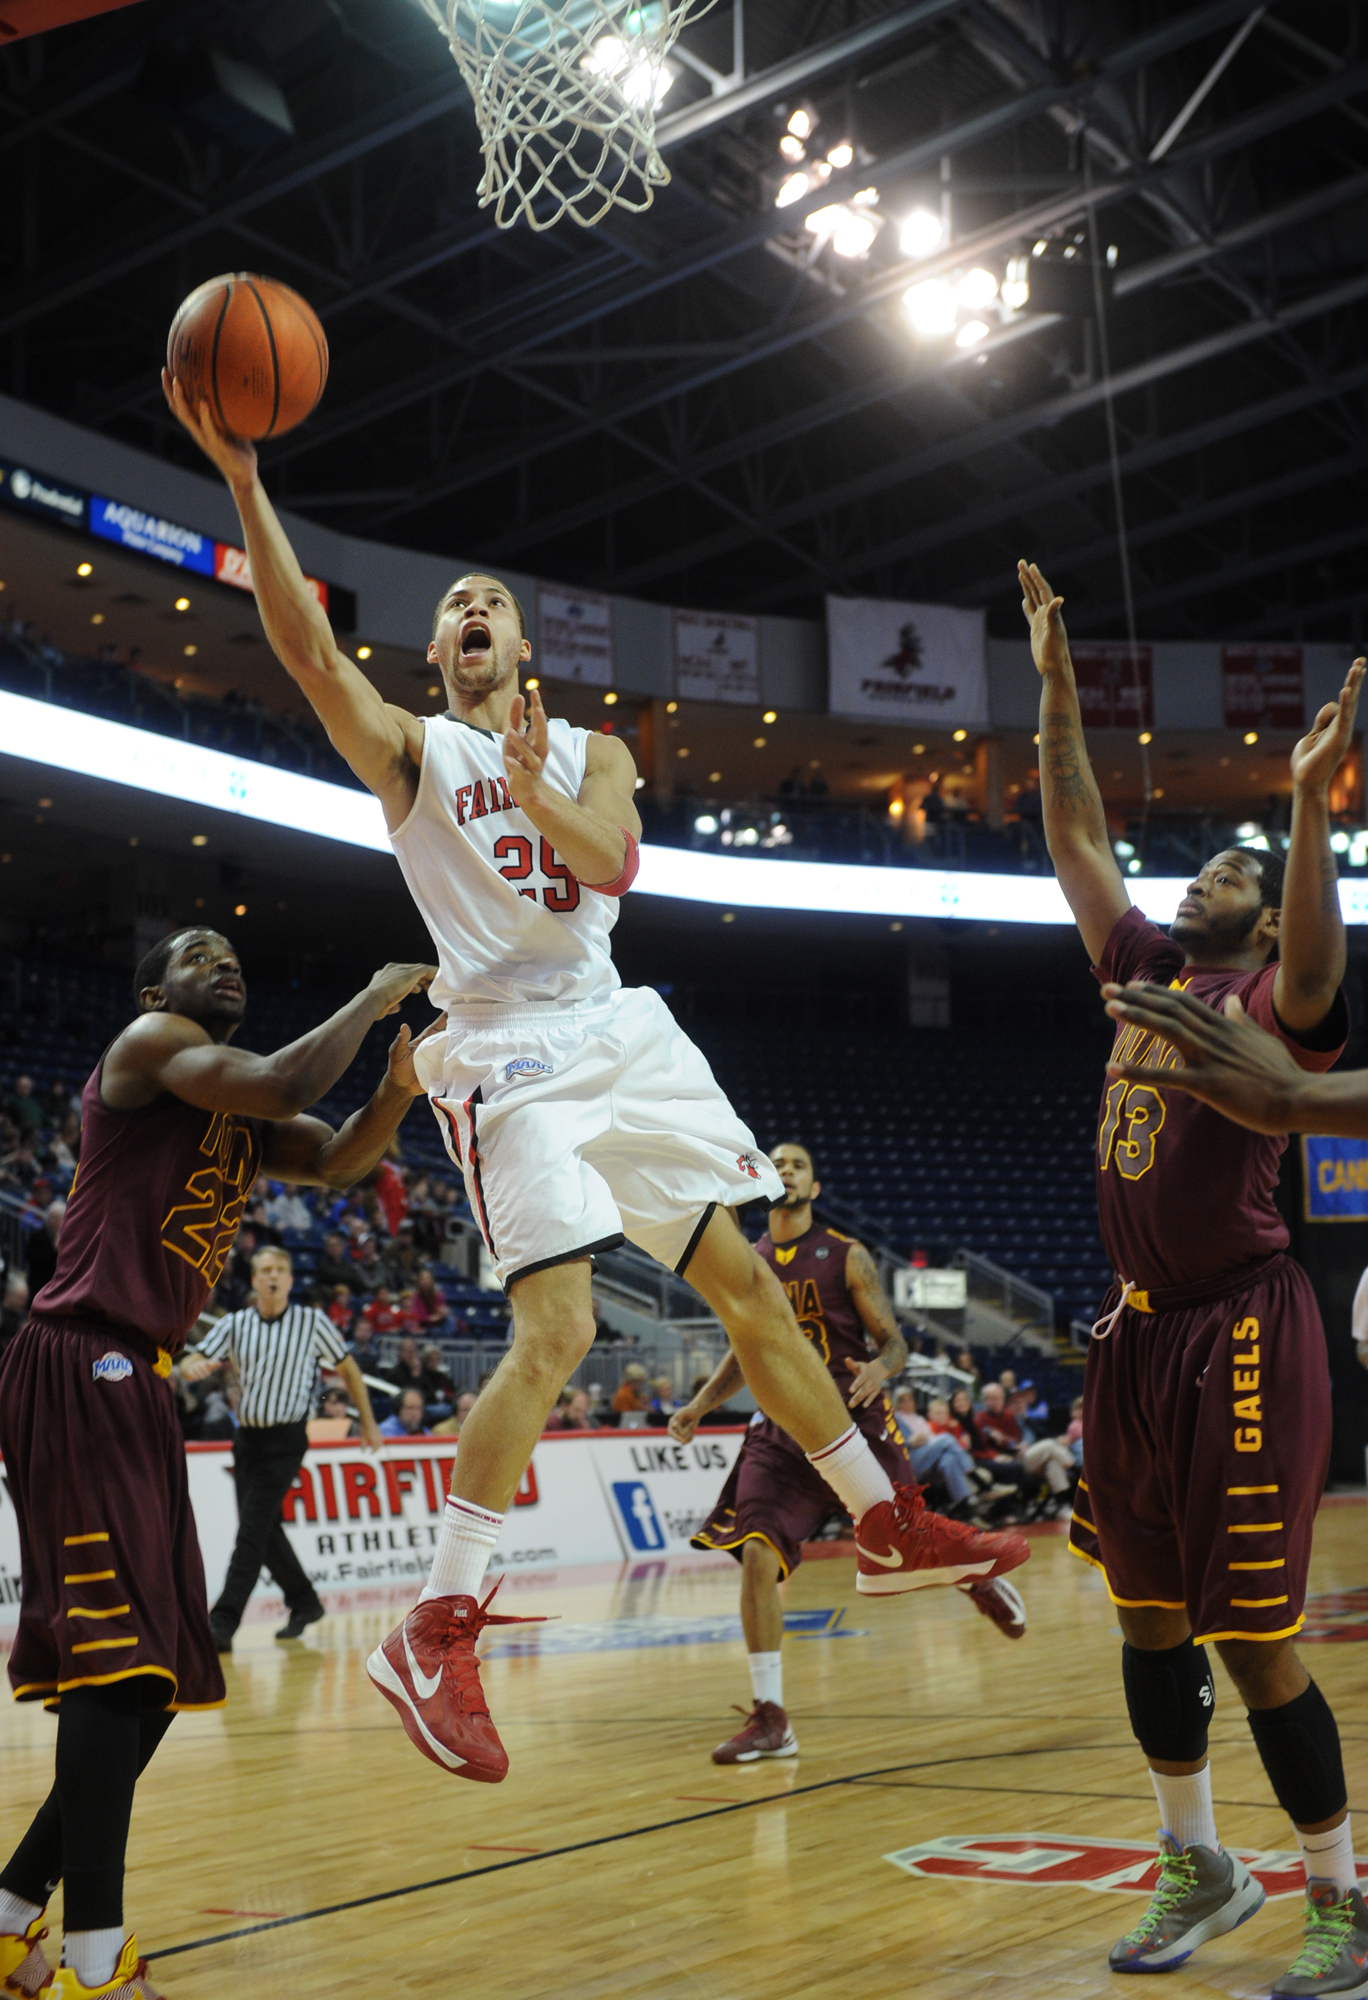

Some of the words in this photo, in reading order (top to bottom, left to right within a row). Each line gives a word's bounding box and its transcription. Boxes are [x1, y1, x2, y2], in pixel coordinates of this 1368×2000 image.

[494, 835, 581, 913] 25
[1100, 1079, 1166, 1181] 13
[161, 1166, 248, 1289] 22
[1232, 1316, 1263, 1453] GAELS
[629, 1446, 689, 1472] LIKE
[693, 1443, 728, 1469] US
[453, 1608, 468, 1618] FUSE
